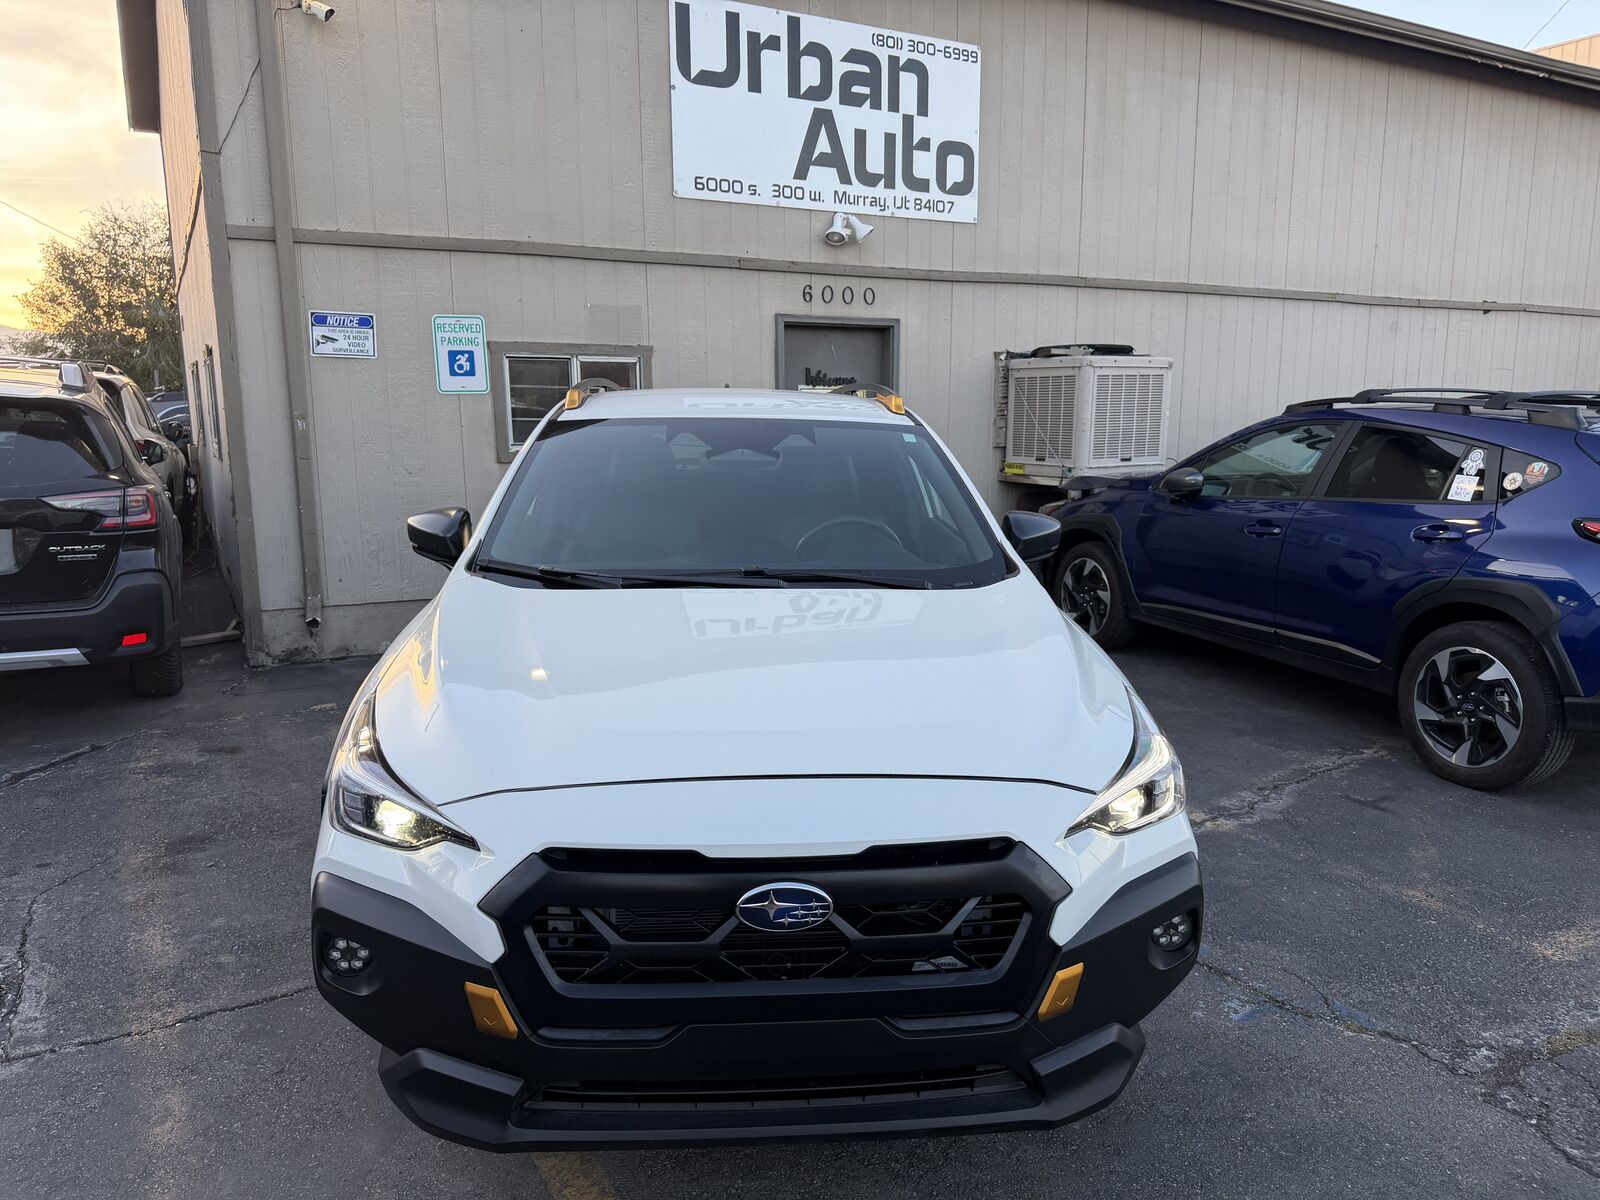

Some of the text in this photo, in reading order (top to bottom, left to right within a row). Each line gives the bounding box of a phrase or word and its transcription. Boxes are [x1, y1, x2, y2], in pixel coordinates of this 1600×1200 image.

[871, 32, 978, 64] (801) 300-6999
[675, 1, 929, 117] Urban
[792, 107, 975, 196] Auto
[694, 176, 744, 195] 6000
[771, 184, 805, 201] 300
[833, 190, 890, 211] Murray,
[913, 199, 954, 214] 84107
[802, 284, 875, 305] 6000
[326, 315, 360, 326] NOTICE
[436, 323, 481, 333] RESERVED
[440, 336, 480, 346] PARKING
[48, 544, 106, 552] OUTBACK
